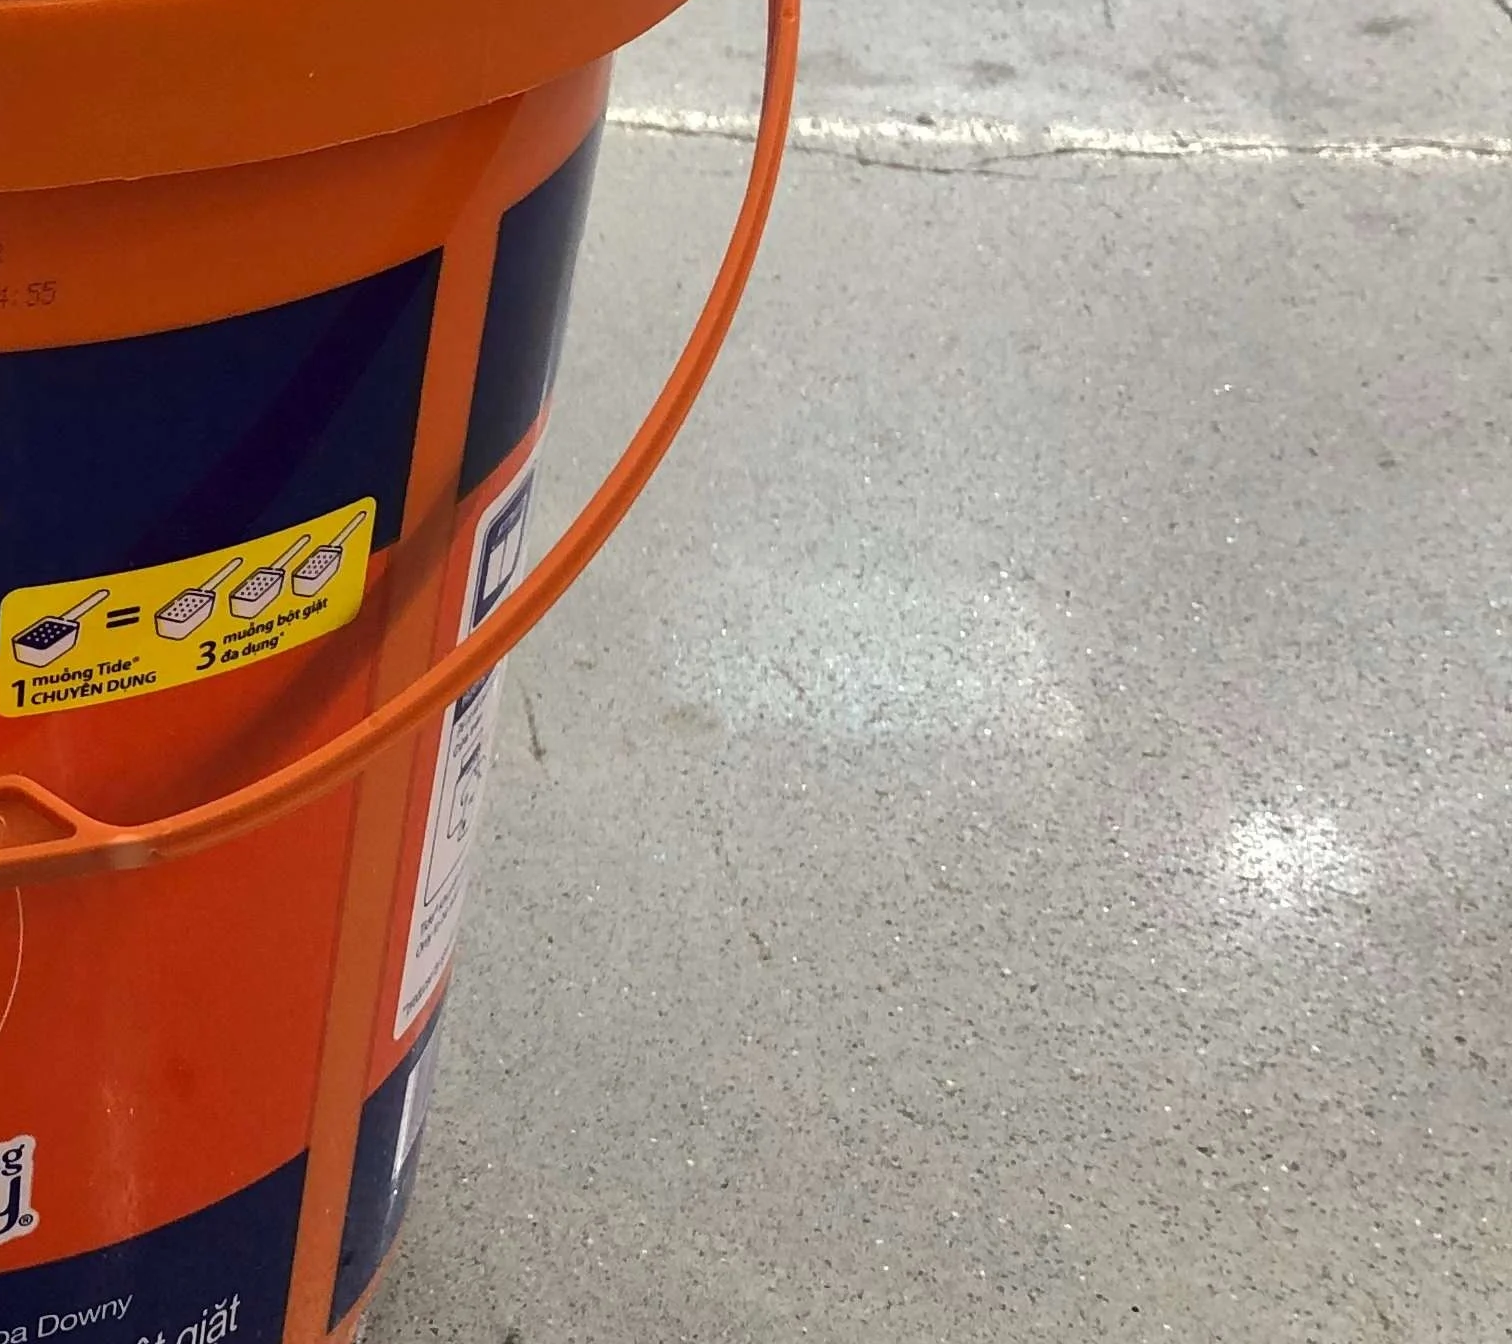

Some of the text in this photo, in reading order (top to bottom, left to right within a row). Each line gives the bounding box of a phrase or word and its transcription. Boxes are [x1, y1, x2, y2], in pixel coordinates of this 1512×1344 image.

[195, 639, 217, 671] 3
[11, 678, 26, 708] 1
[107, 670, 158, 693] DỤNG
[38, 1293, 134, 1339] Downy
